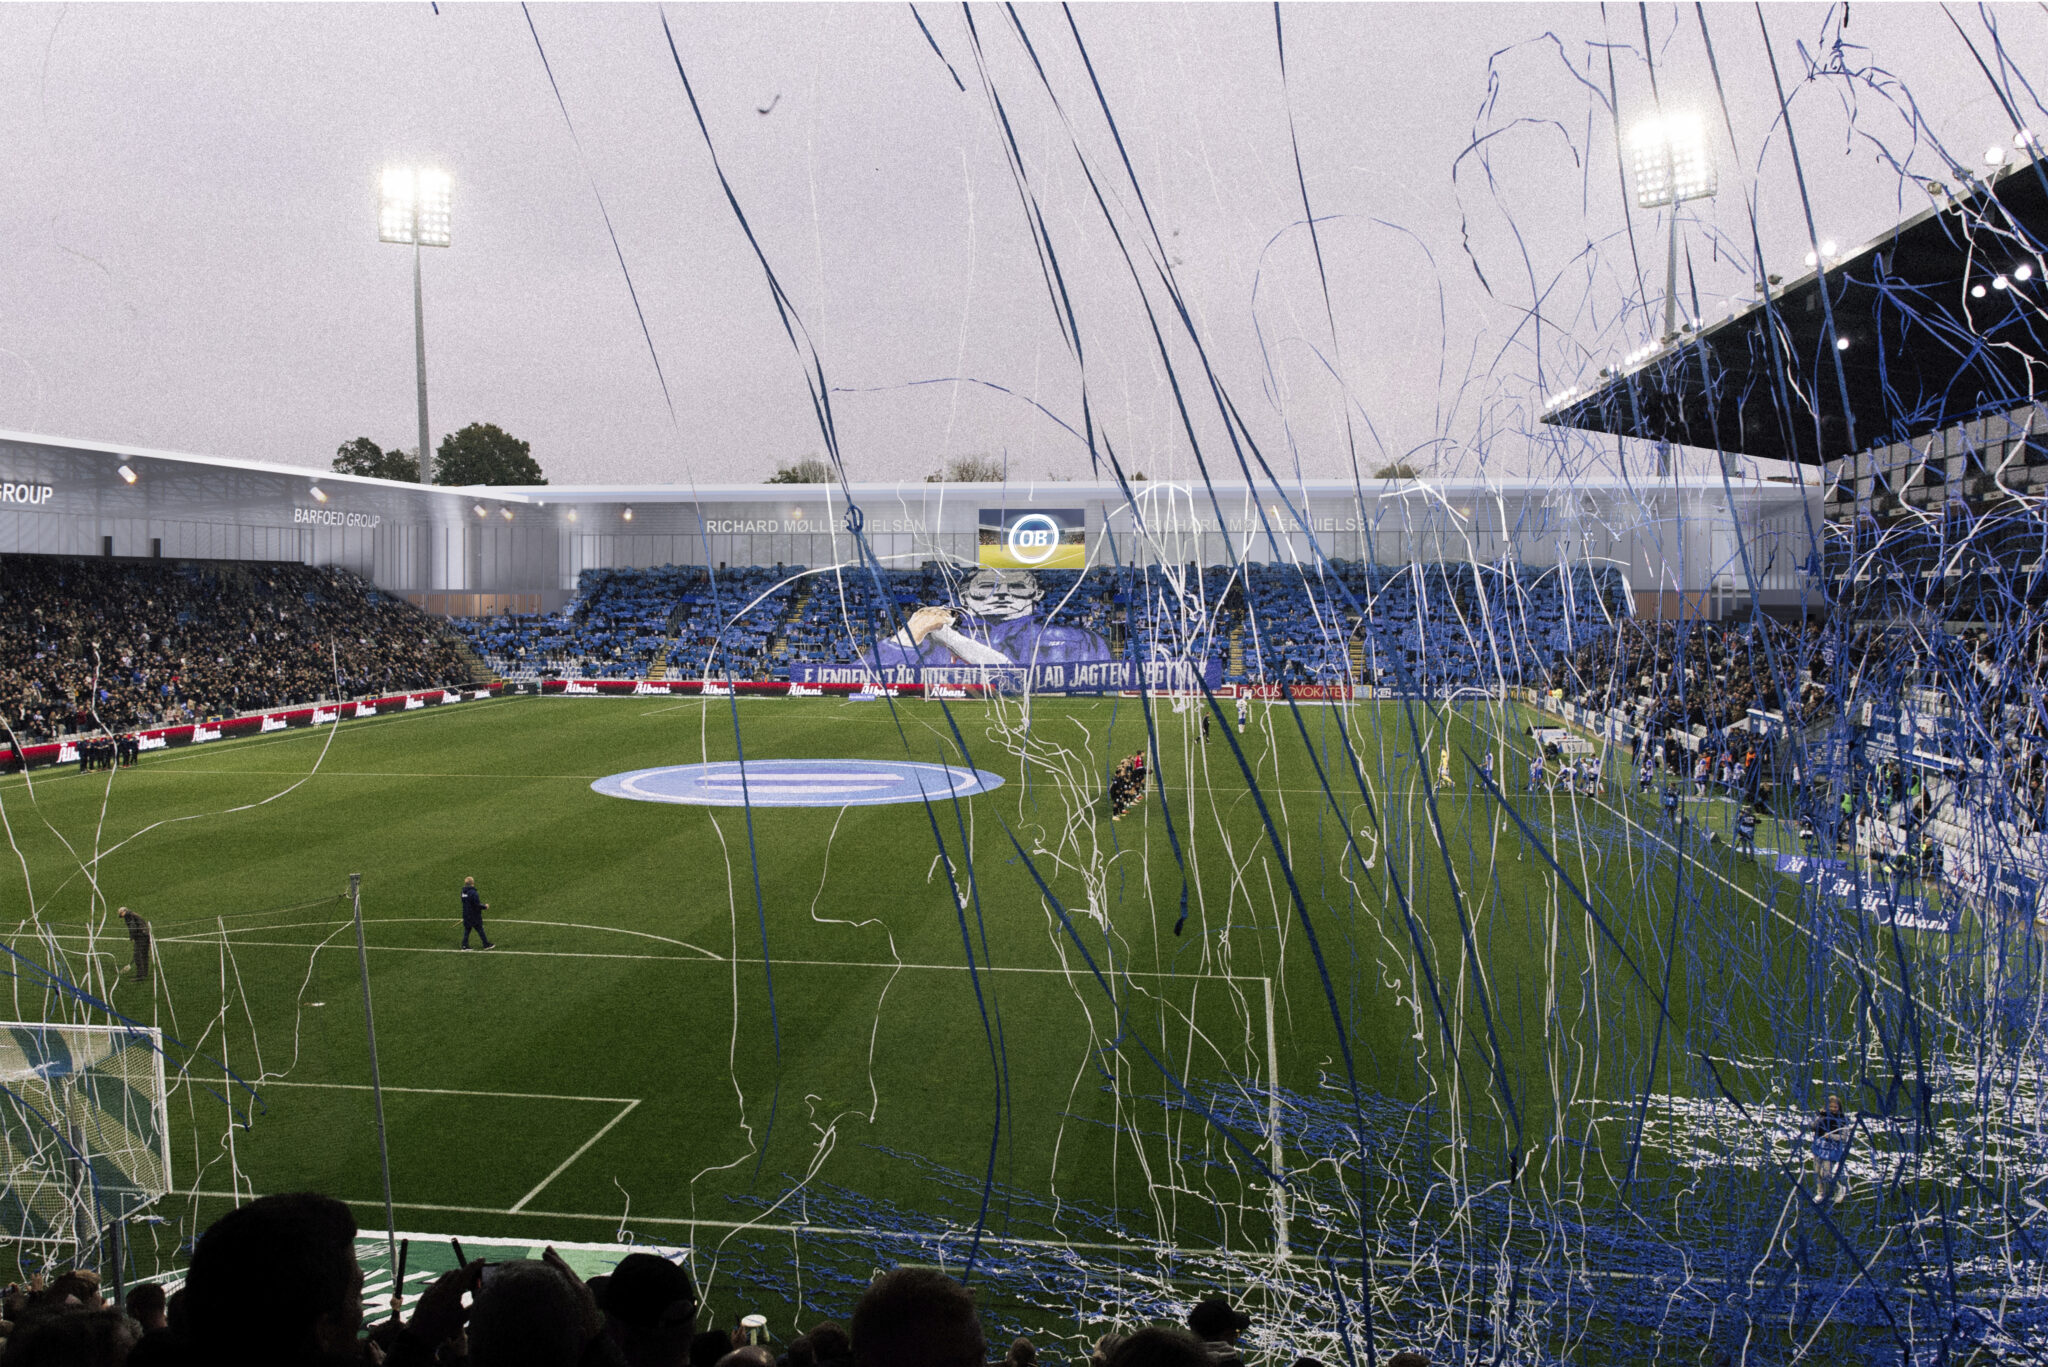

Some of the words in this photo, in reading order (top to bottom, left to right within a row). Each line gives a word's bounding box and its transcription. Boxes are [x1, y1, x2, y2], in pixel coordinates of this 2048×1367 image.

[294, 508, 344, 526] BARFOED
[346, 513, 381, 528] GROUP
[706, 520, 779, 533] RICHARD
[784, 519, 849, 533] MØLLER
[1019, 530, 1048, 547] OB
[1035, 664, 1065, 688] LAD
[1069, 662, 1131, 688] JAGTEN
[564, 681, 598, 694] Albani
[632, 681, 671, 694] Albani
[787, 683, 823, 696] Albani
[930, 684, 966, 697] Albani
[191, 724, 222, 743] Albani
[137, 732, 167, 751] lbani
